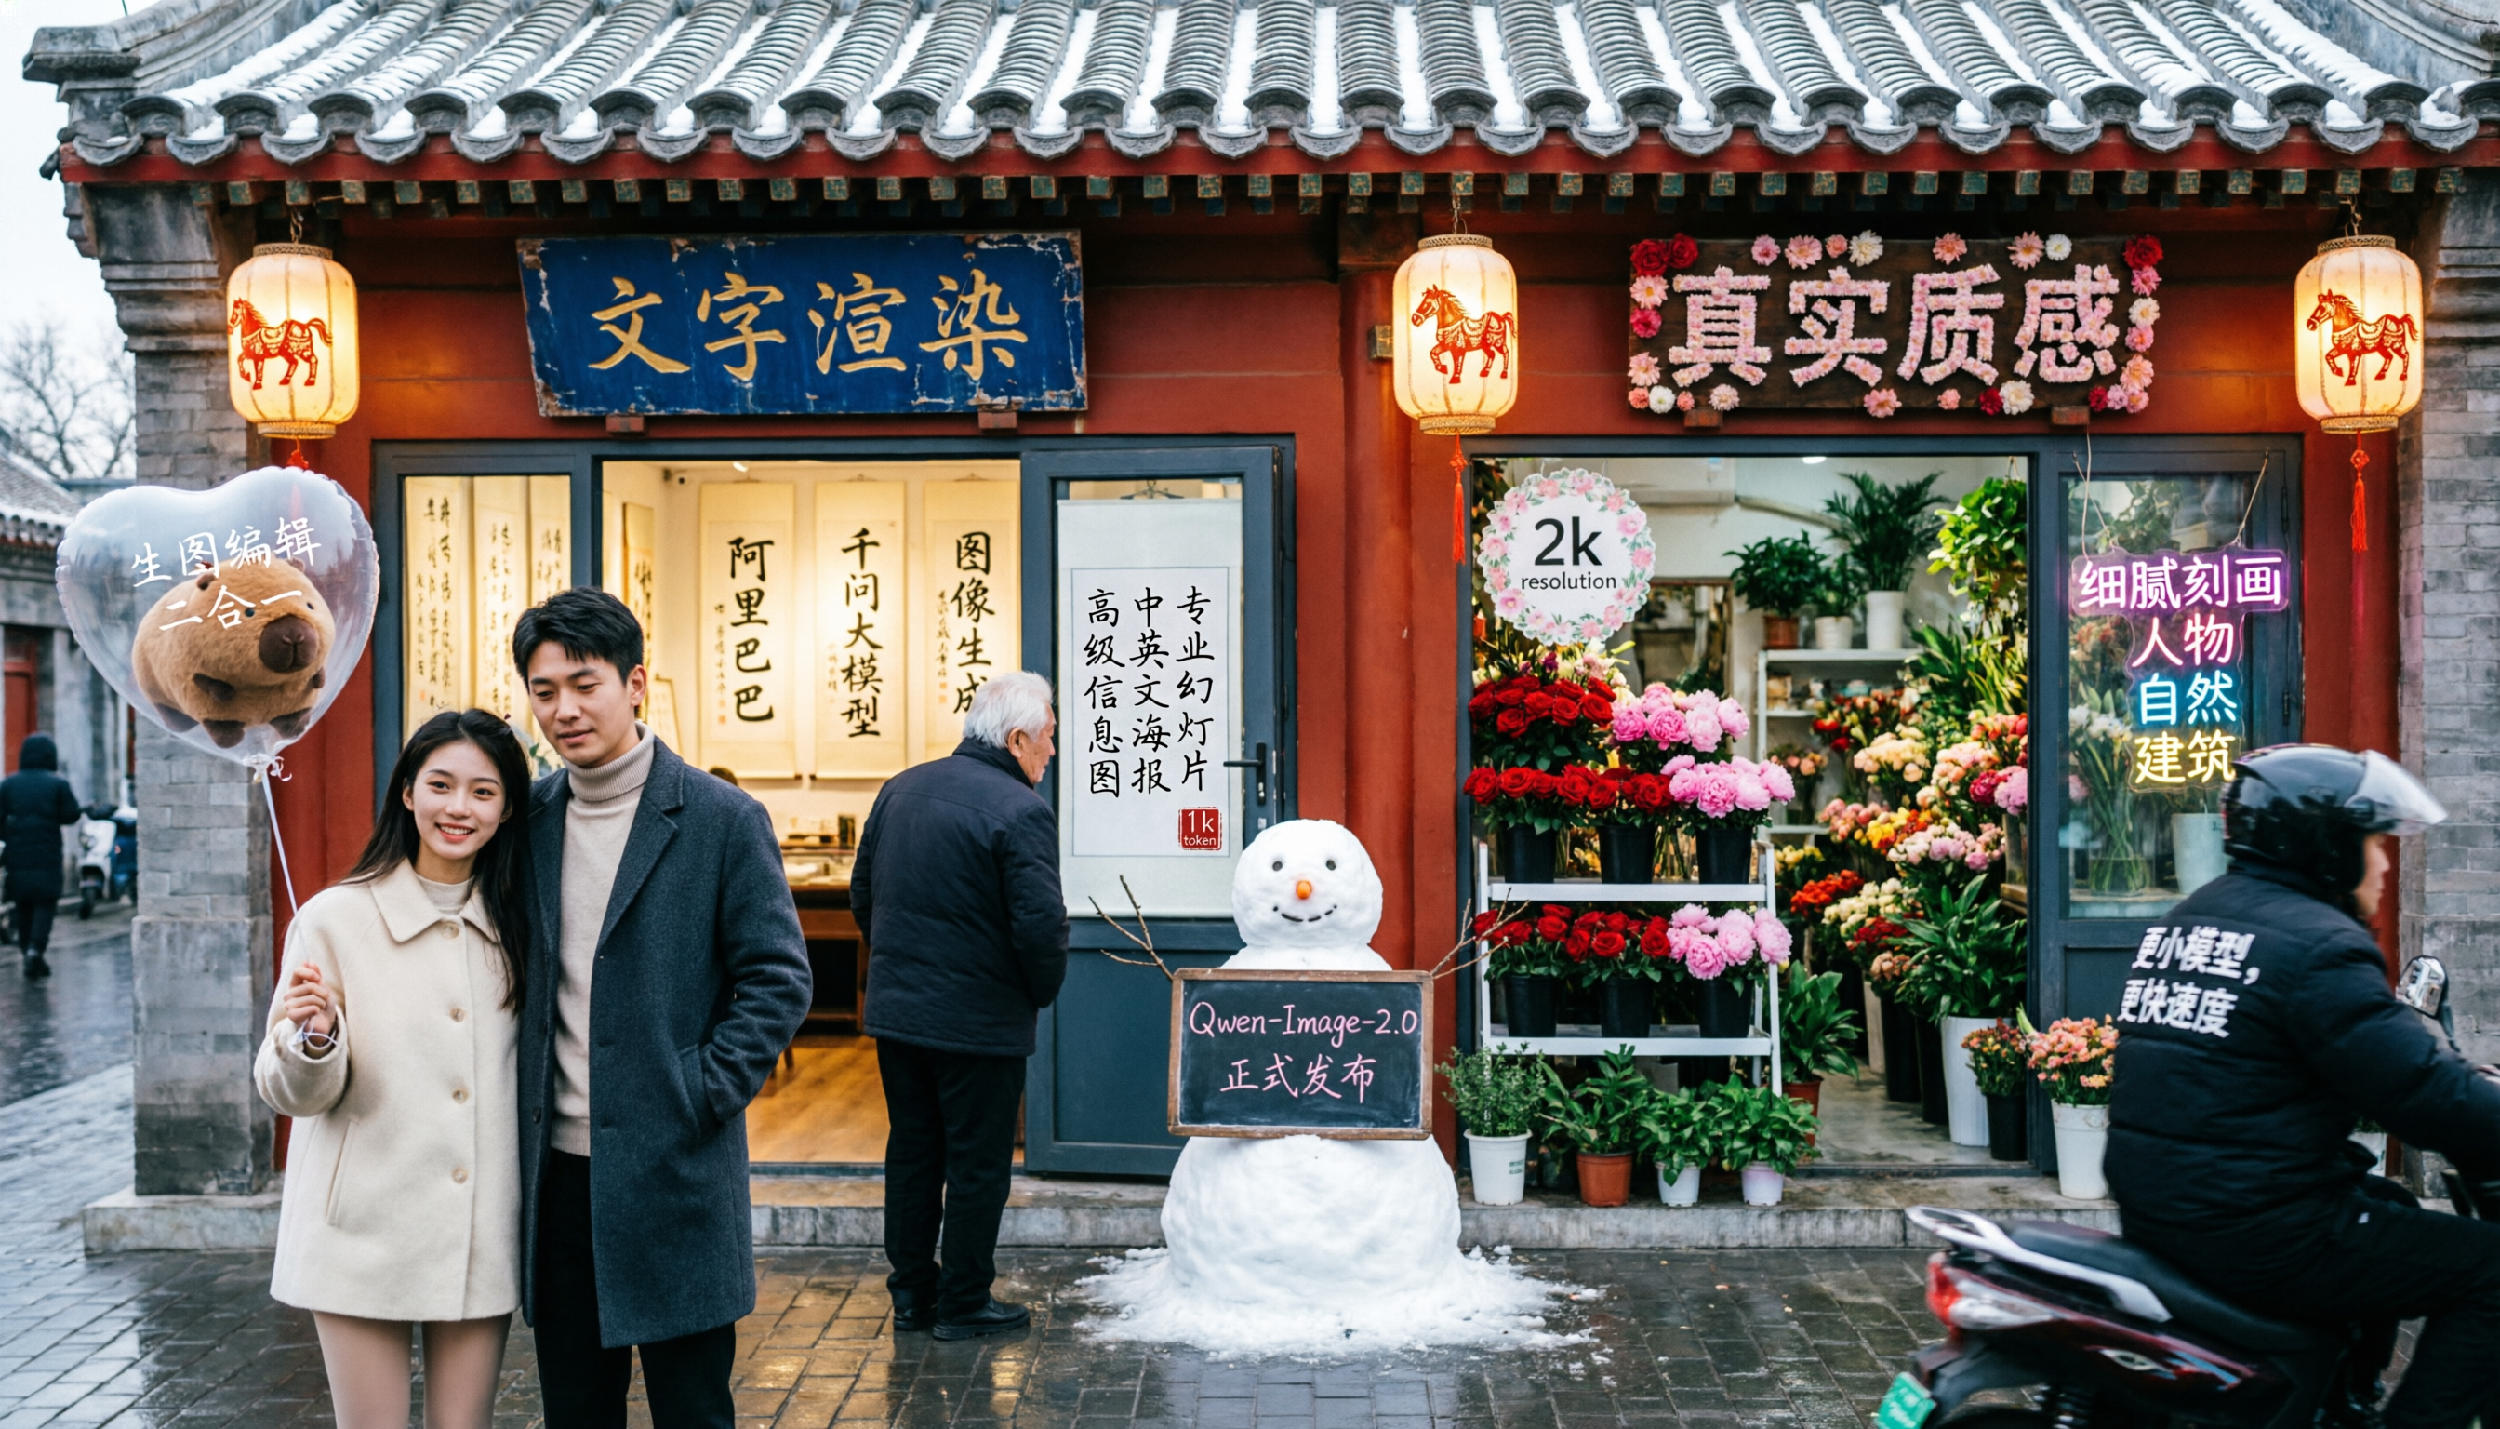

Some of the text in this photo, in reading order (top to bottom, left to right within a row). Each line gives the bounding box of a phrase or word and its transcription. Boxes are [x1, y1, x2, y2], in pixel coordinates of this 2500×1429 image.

[588, 269, 1028, 381] 文字渲染
[1669, 263, 2120, 386] 真实质感
[131, 516, 322, 587] 生图编辑
[1534, 515, 1603, 567] 2k
[158, 584, 302, 631] 二合一
[1521, 571, 1617, 590] resolution
[2078, 554, 2283, 609] 细腻刻画
[727, 537, 775, 723] 阿里巴巴
[840, 527, 884, 738] 千问大模型
[2131, 613, 2235, 667] 人物
[1083, 588, 1126, 798] 高级信息图
[1129, 586, 1172, 795] 中英文海报
[1176, 585, 1216, 792] 专业幻灯片
[2139, 670, 2238, 726] 自然
[2133, 729, 2237, 784] 建筑
[1183, 834, 1218, 847] token
[1189, 1001, 1418, 1048] Qwen-Image-2.0
[2116, 977, 2239, 1038] 更快速度
[1219, 1052, 1377, 1104] 正式发布
